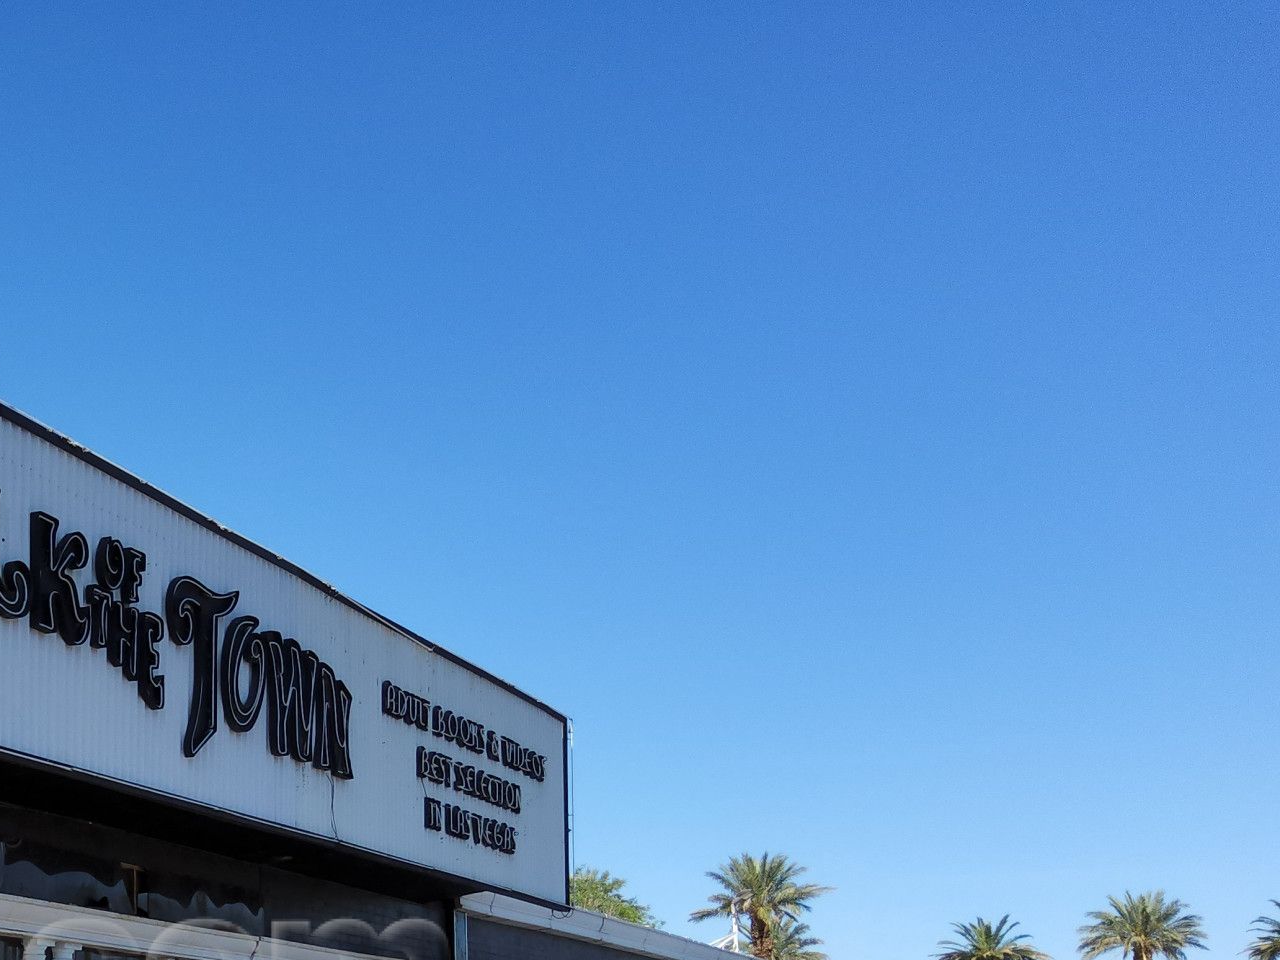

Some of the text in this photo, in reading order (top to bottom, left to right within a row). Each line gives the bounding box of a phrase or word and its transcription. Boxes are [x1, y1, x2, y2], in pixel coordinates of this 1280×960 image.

[95, 536, 147, 603] OF
[87, 584, 164, 710] THE
[166, 575, 354, 779] TOWN
[382, 680, 547, 782] ADULT BOOKS & VIDEOS
[416, 746, 521, 813] BEST SELECTION
[424, 797, 517, 854] IN LAS VEGAS
